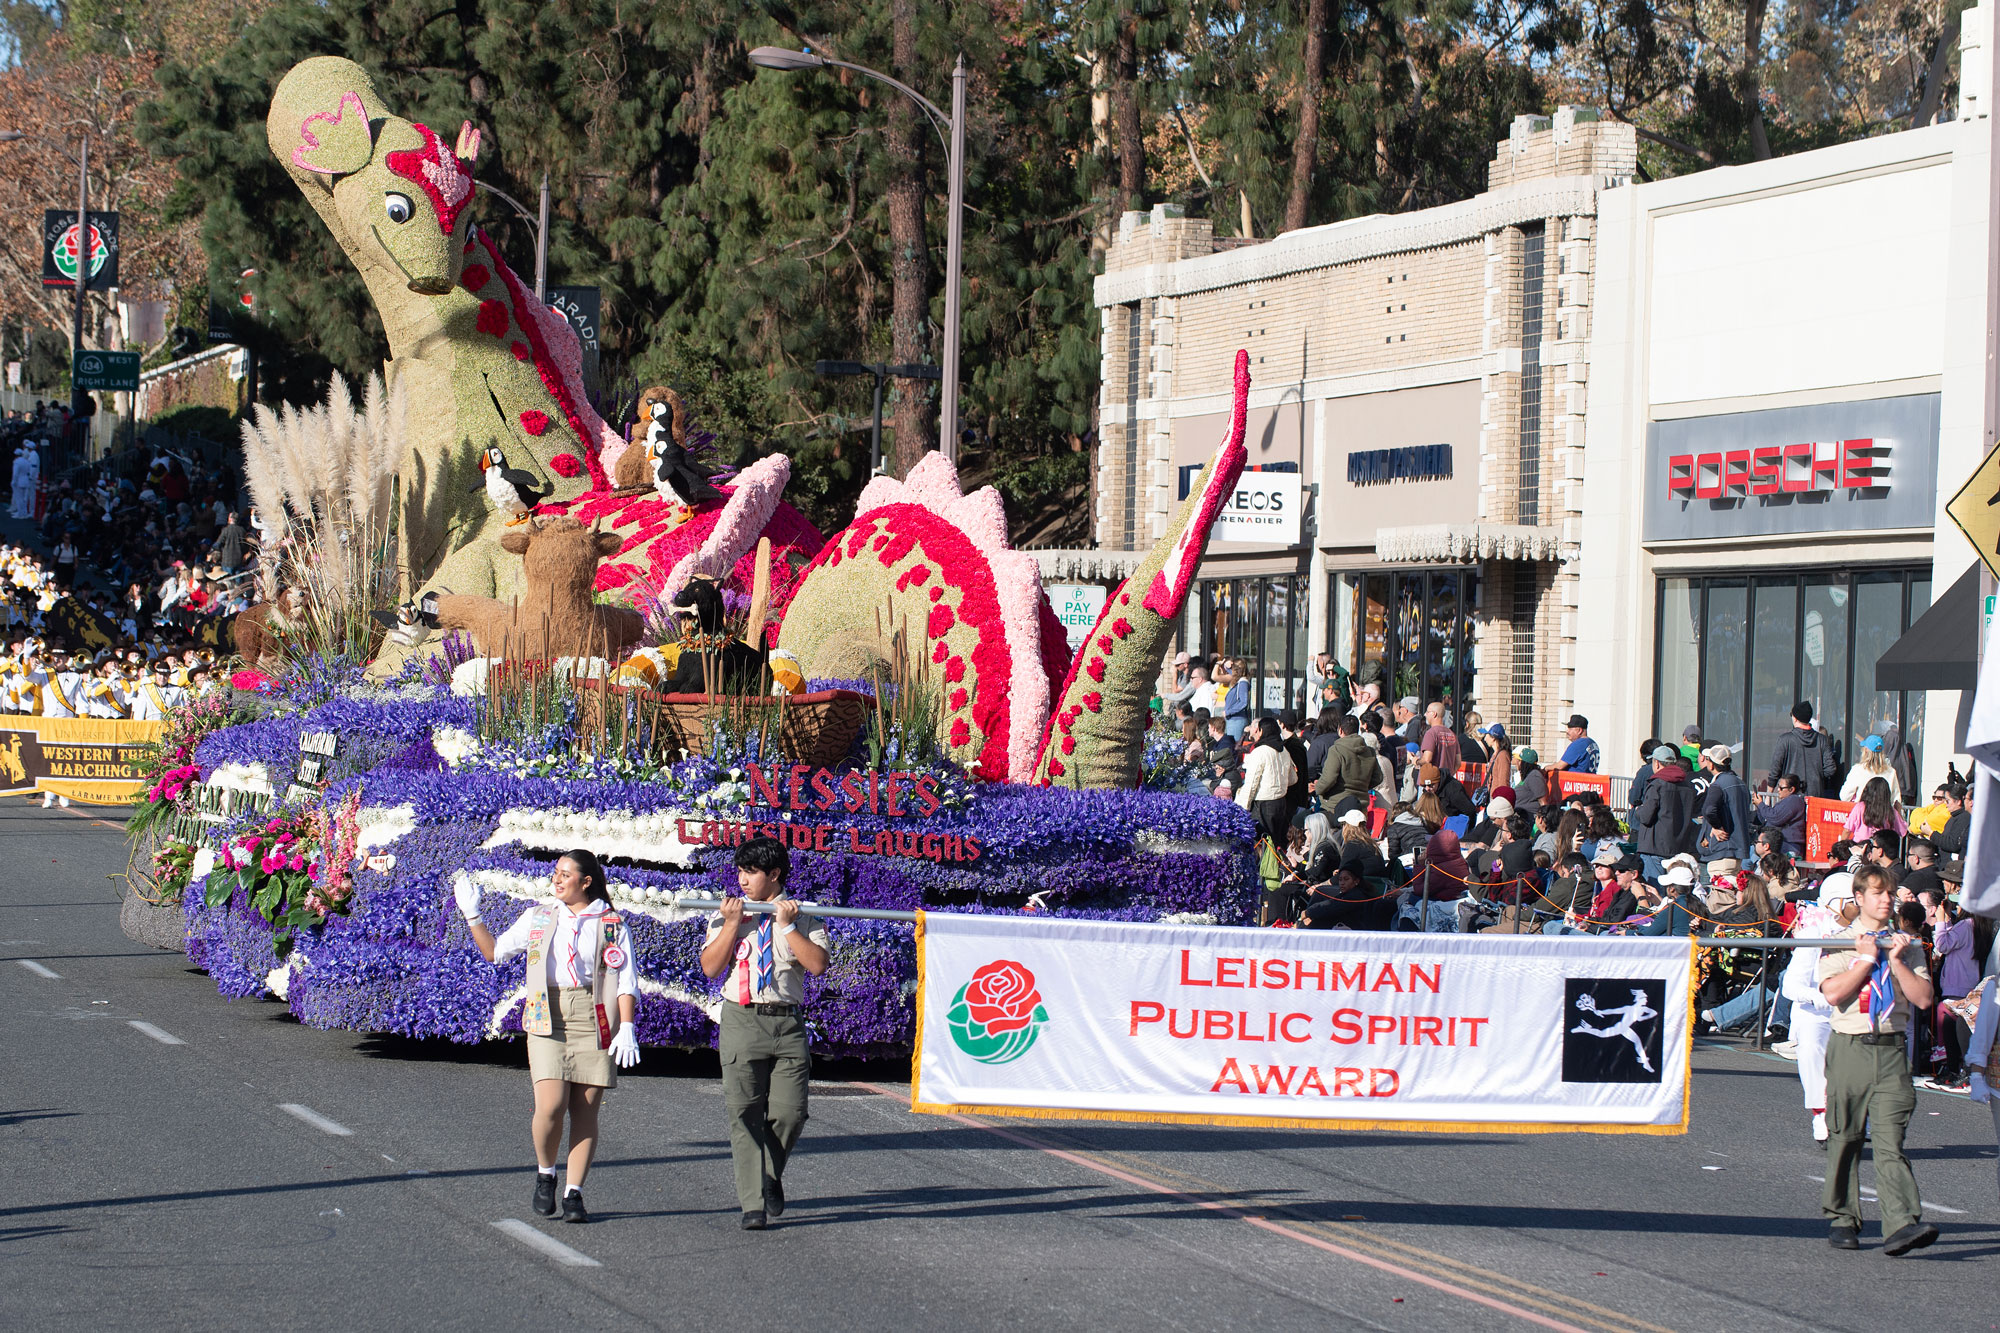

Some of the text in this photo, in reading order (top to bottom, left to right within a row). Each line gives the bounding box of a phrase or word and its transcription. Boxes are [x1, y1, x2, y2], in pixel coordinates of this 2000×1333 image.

[83, 356, 132, 371] 134 WEST
[77, 377, 135, 387] RIGHT LANE
[1668, 438, 1893, 501] PORSCHE
[1224, 490, 1283, 511] EOS
[1218, 516, 1283, 524] RENADIER
[1065, 601, 1091, 613] PAY
[1060, 614, 1096, 626] HERE
[42, 746, 112, 761] WESTERN
[50, 762, 132, 778] MARCHING
[745, 762, 941, 818] NESSIE'S
[847, 827, 982, 863] LAUGHS
[1179, 949, 1441, 993] LEISHMAN
[1128, 1001, 1490, 1047] PUBLIC SPIRIT
[1209, 1056, 1401, 1099] AWARD
